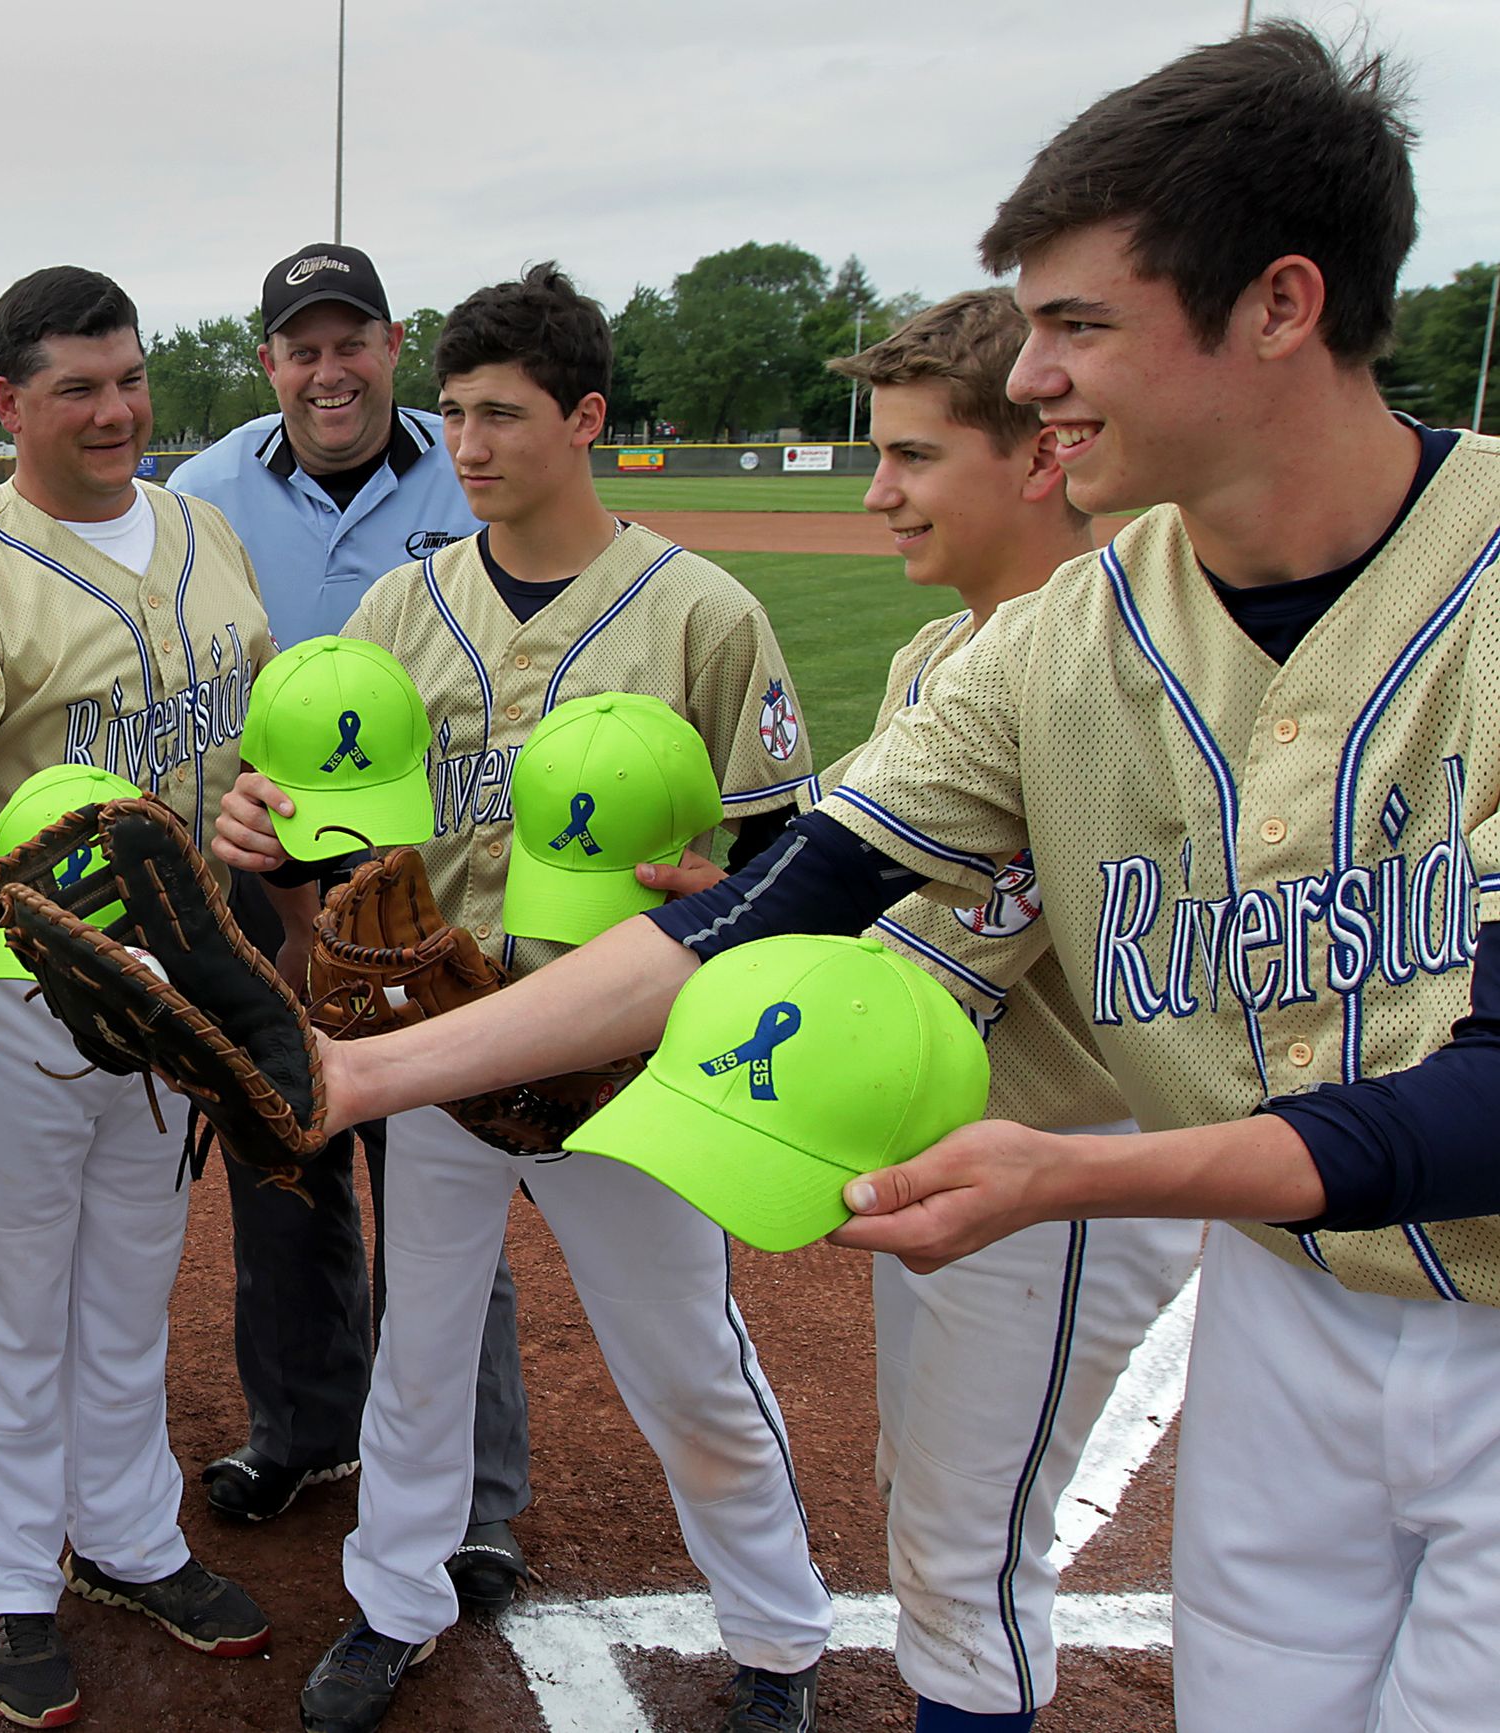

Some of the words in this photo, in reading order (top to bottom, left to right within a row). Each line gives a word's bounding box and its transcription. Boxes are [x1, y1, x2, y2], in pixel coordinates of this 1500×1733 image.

[301, 259, 350, 275] UMPIRES
[422, 536, 468, 549] UMPI
[350, 746, 365, 763] 35
[579, 831, 594, 847] 35
[710, 1052, 738, 1074] KS
[752, 1059, 770, 1086] 35
[456, 1544, 515, 1559] Reebok
